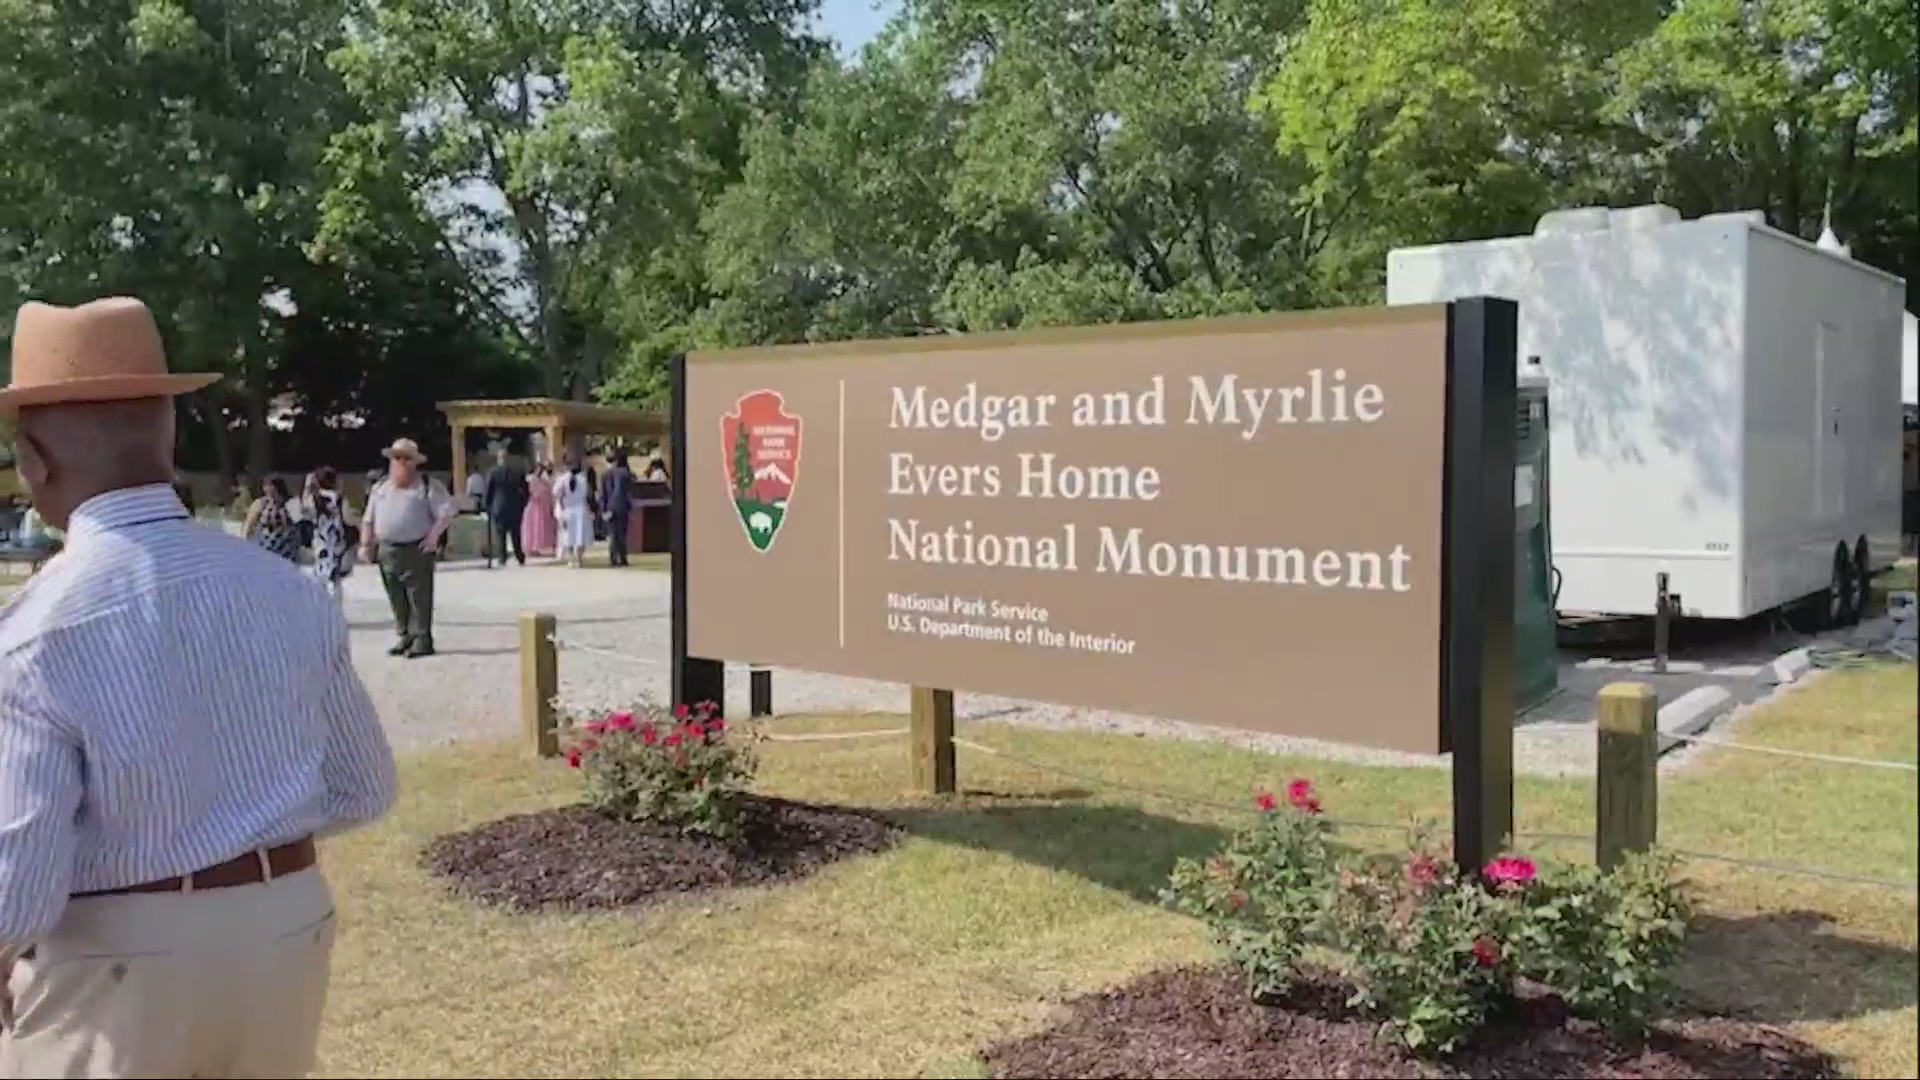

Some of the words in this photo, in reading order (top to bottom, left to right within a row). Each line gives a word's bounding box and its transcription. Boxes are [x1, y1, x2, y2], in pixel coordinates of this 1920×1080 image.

[889, 380, 1057, 442] Medgar
[1072, 374, 1166, 428] and
[1186, 368, 1384, 442] Myrlie
[887, 453, 1001, 498] Evers
[1017, 453, 1161, 502] Home
[887, 518, 1078, 571] National
[1095, 526, 1412, 592] Monument
[887, 592, 949, 614] National
[952, 597, 987, 617] Park
[990, 600, 1049, 623] Service
[887, 613, 916, 633] U.S.
[919, 616, 1012, 642] Department
[1014, 624, 1033, 645] of
[1036, 628, 1066, 648] the
[1069, 631, 1136, 655] Interior
